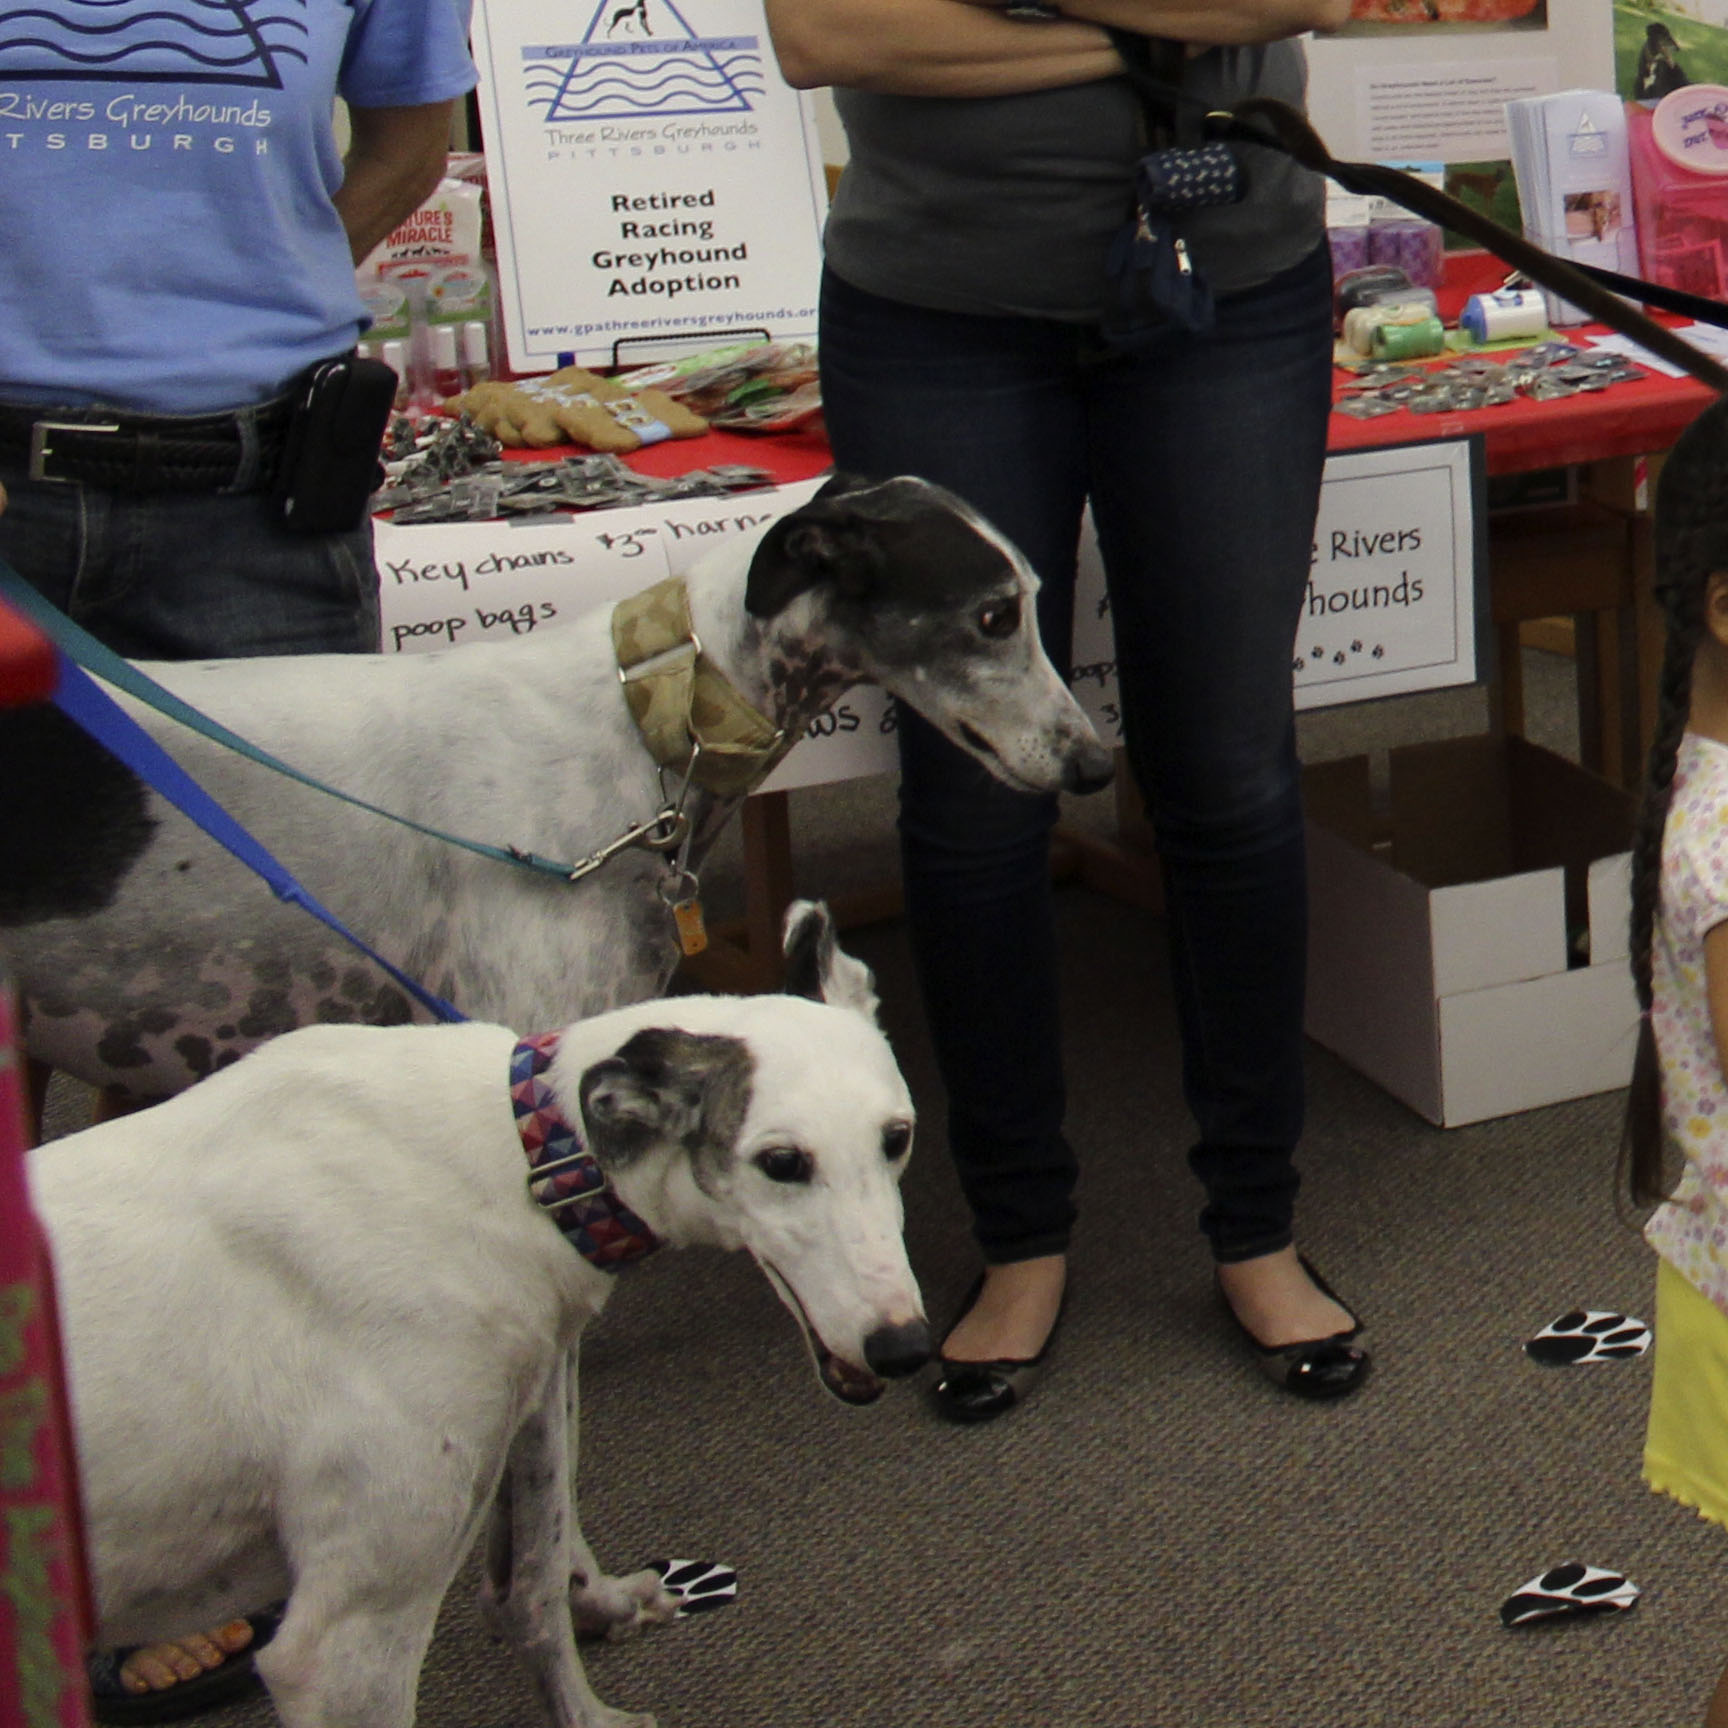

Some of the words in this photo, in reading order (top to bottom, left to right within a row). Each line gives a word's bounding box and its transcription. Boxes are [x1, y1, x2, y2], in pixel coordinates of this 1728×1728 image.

[0, 93, 96, 121] Rivers
[106, 94, 272, 129] Greyhounds
[544, 127, 596, 147] Three
[601, 124, 658, 143] Rivers
[661, 120, 759, 143] Greyhounds
[548, 141, 762, 161] PITTSBURGH
[611, 189, 716, 213] Retired
[386, 228, 454, 249] MIRACLE
[620, 218, 715, 240] Racing
[591, 242, 748, 272] Greyhound
[607, 272, 741, 299] Adoption
[1331, 527, 1421, 562] Rivers
[391, 616, 467, 652] poop
[476, 599, 557, 634] bags
